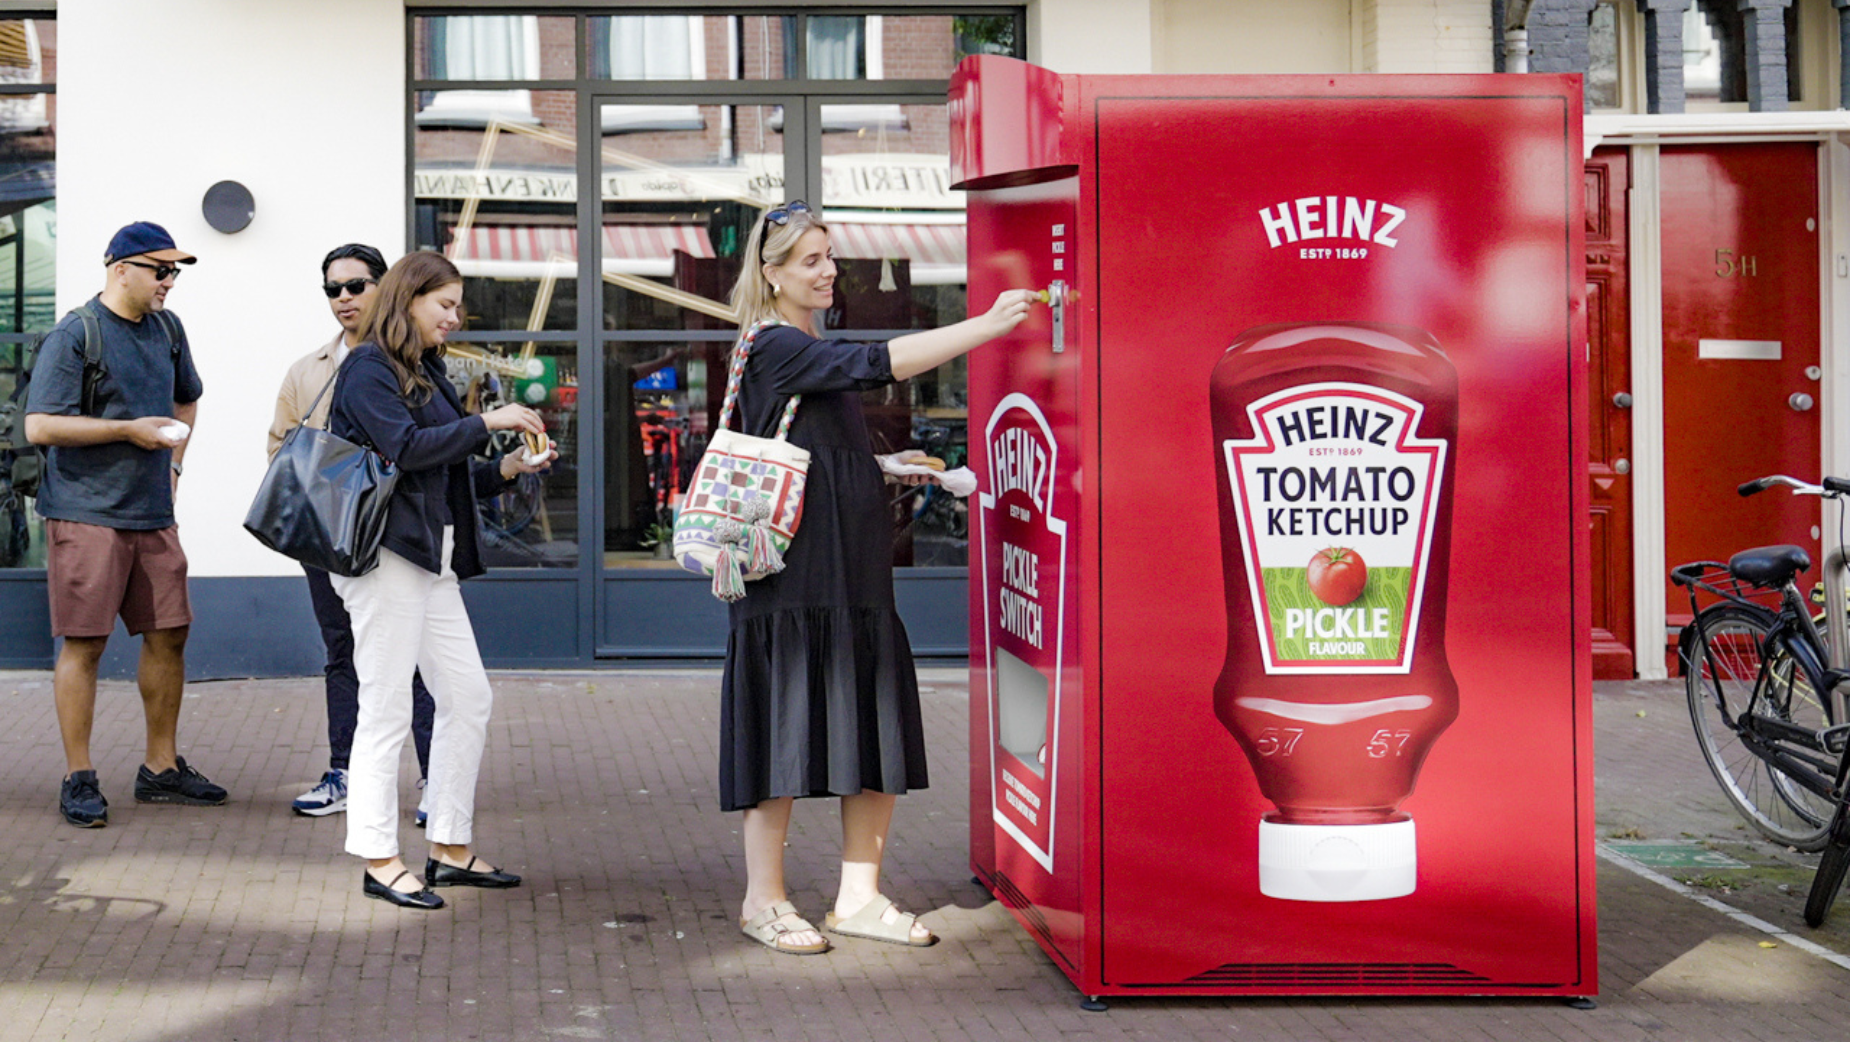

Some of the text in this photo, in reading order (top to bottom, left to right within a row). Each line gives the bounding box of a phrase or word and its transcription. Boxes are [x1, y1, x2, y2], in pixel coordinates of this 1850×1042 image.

[1258, 195, 1406, 249] HEINZ
[1335, 248, 1368, 260] 1869
[1276, 406, 1394, 447] HEINZ
[1338, 447, 1363, 457] 1869
[994, 427, 1046, 514] HEINZ
[1256, 465, 1416, 502] TOMATO
[1267, 507, 1409, 536] KETCHUP
[1003, 541, 1038, 599] PICKLE
[1000, 586, 1042, 650] SWITCH
[1285, 607, 1389, 638] PICKLE
[1309, 641, 1366, 655] FLAVOUR
[1257, 727, 1304, 757] 57
[1366, 729, 1412, 758] 57
